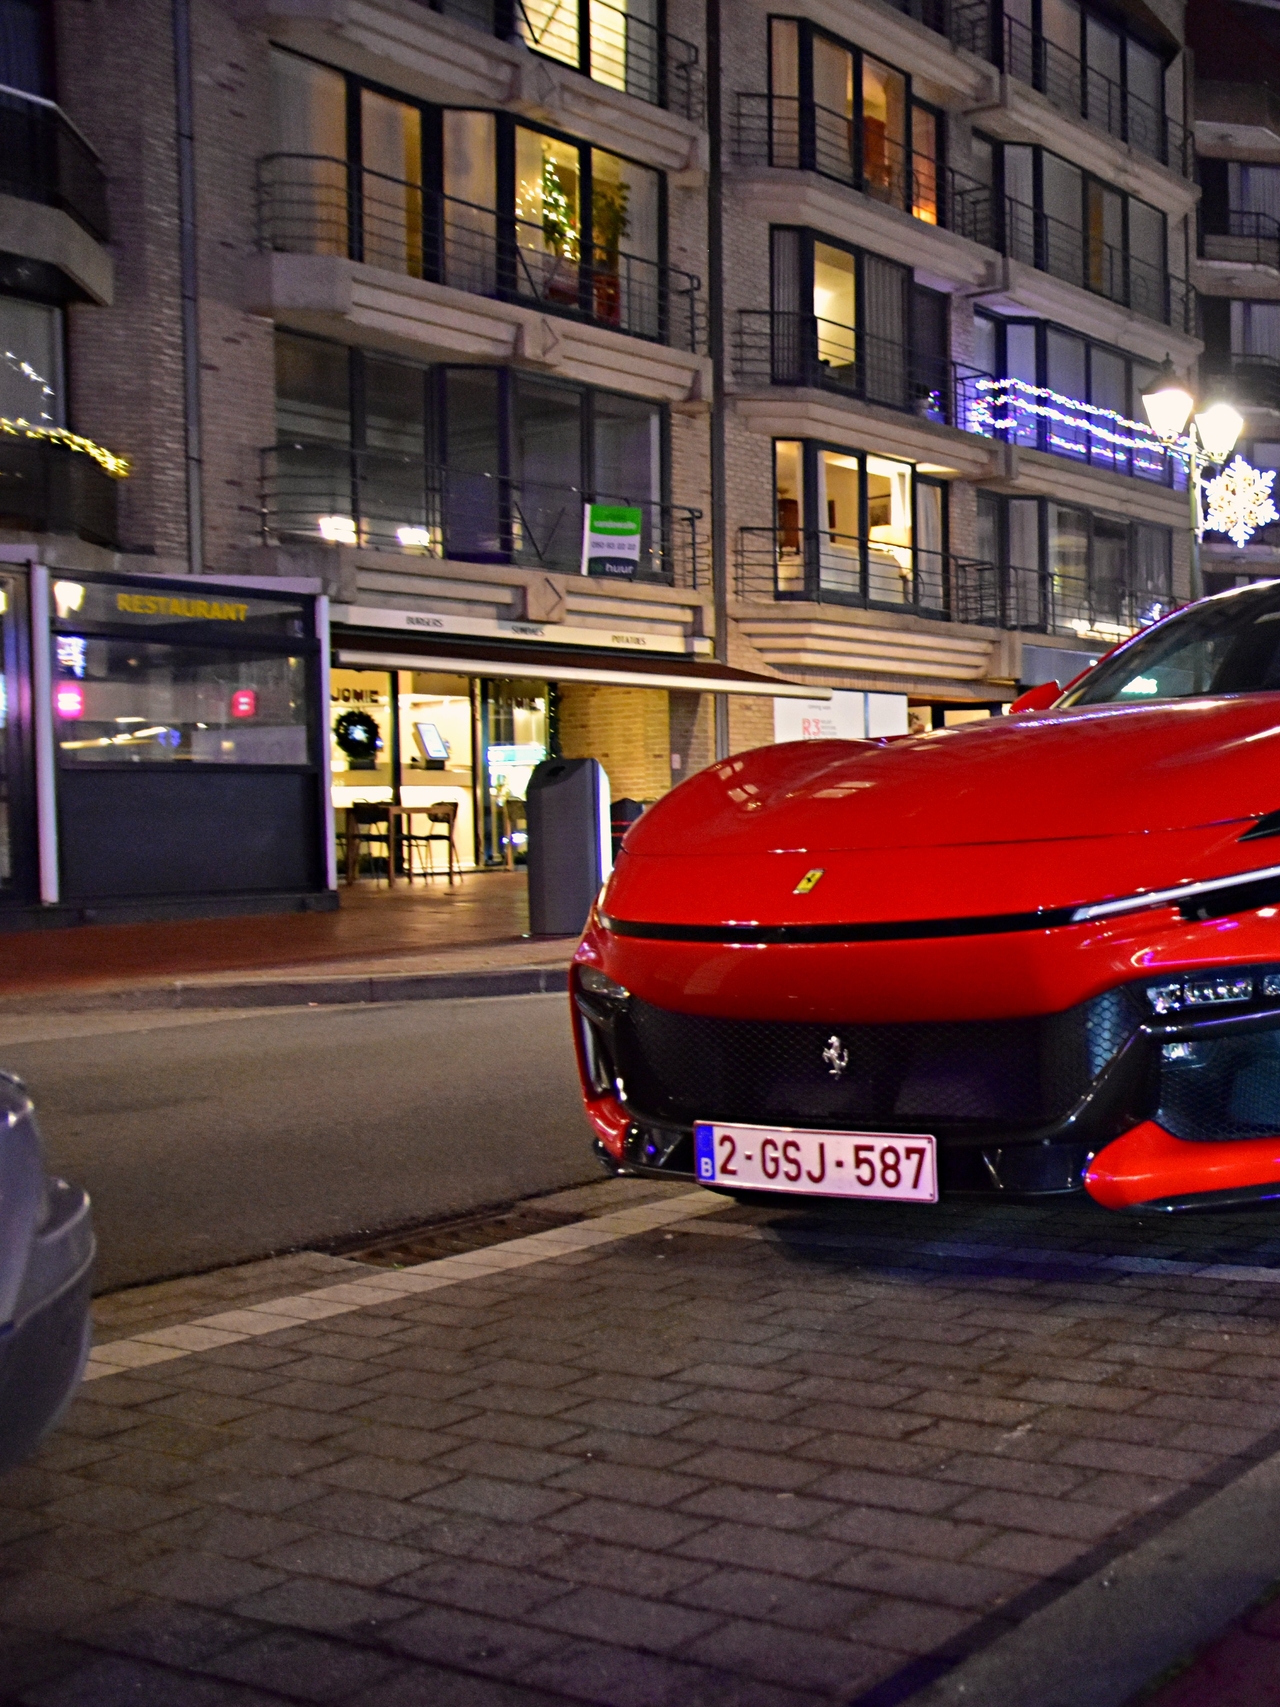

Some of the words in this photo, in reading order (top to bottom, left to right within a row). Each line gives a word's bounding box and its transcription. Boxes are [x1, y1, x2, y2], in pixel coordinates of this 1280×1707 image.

[117, 593, 249, 622] RESTAURANT
[406, 616, 443, 628] BURGERS
[612, 634, 647, 646] POTATOES
[330, 687, 379, 704] JOMIE
[802, 718, 821, 736] R3
[701, 1157, 713, 1177] B
